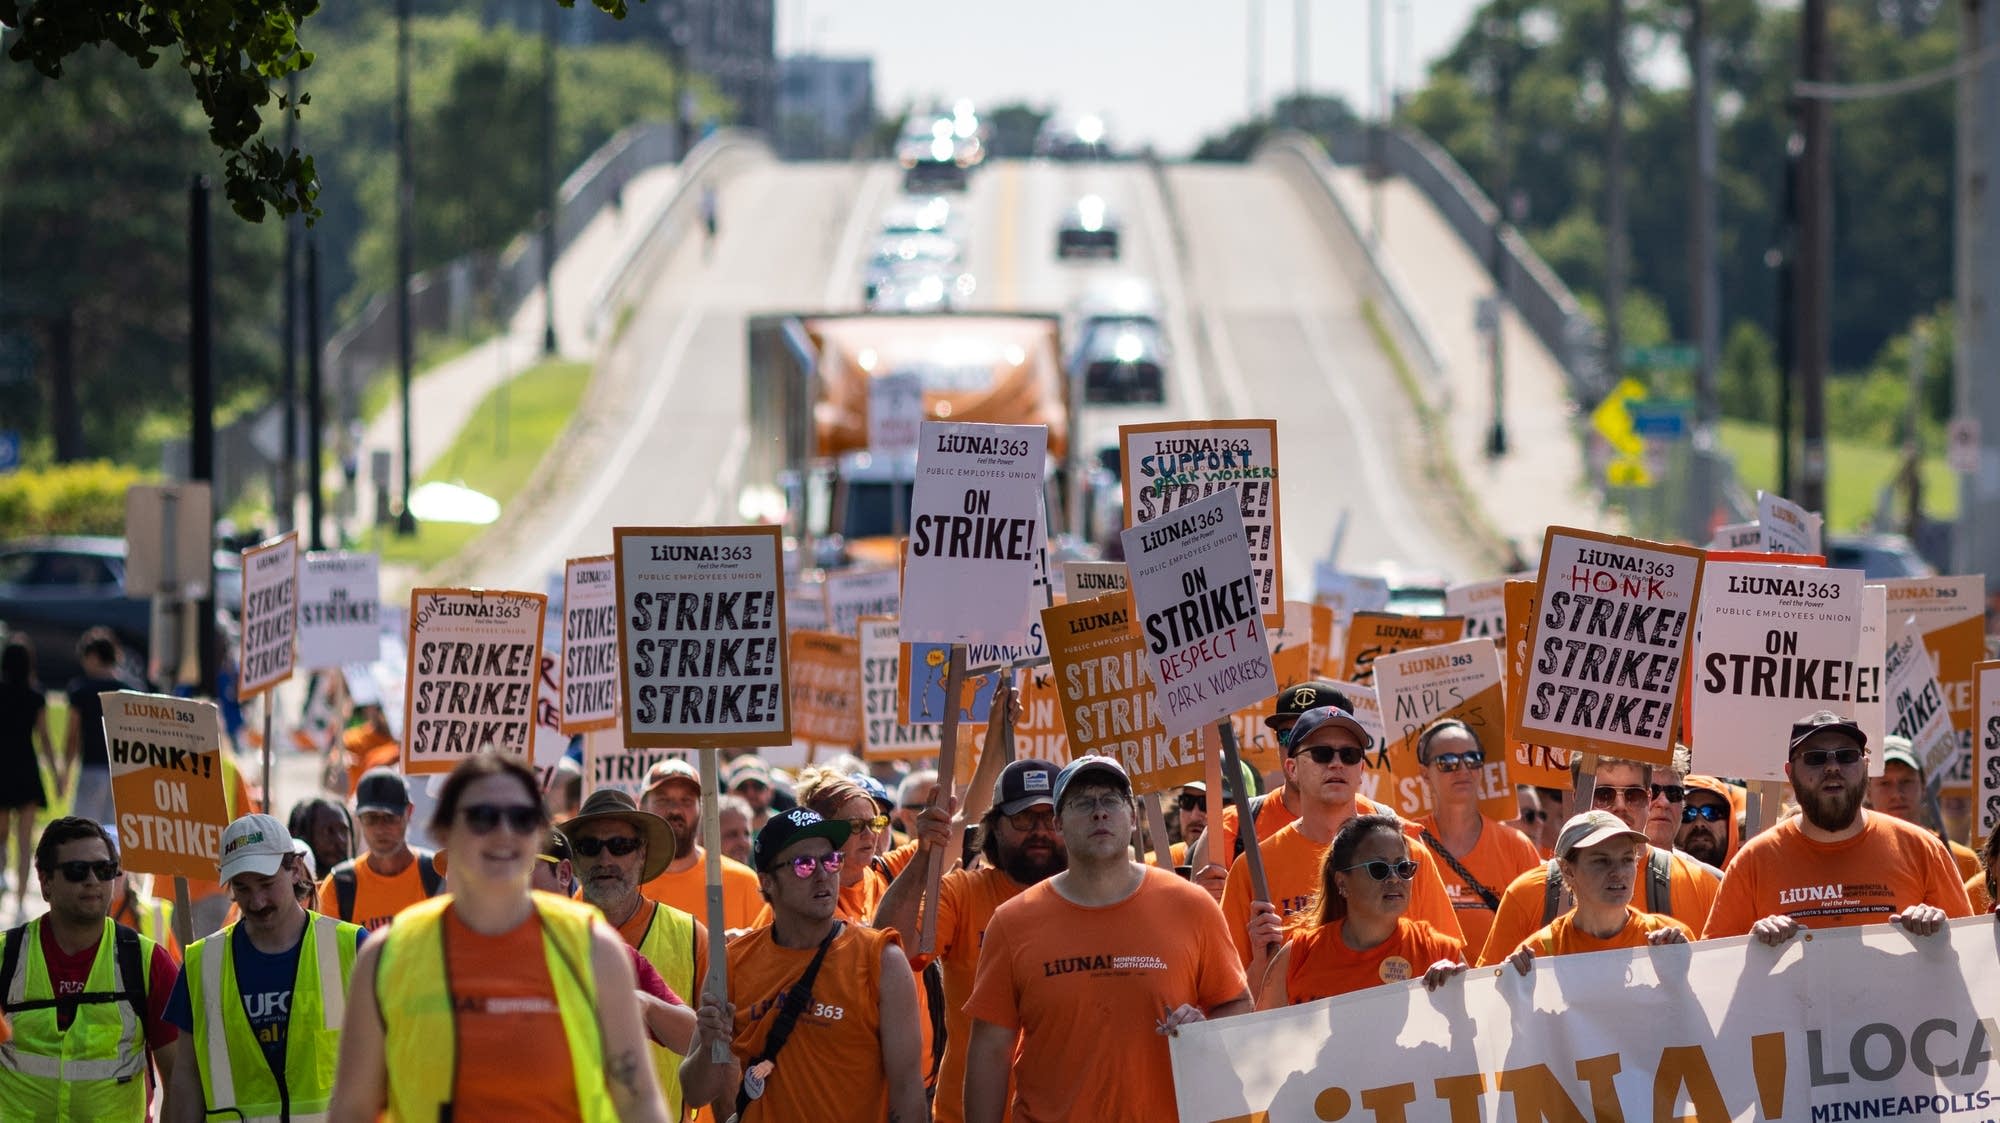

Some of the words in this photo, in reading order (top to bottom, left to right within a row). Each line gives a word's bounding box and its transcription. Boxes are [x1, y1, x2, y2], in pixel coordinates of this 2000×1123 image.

[937, 434, 998, 455] LiUNA!
[1000, 440, 1028, 456] 363
[1155, 438, 1218, 455] LiUNA!
[1221, 439, 1249, 452] 363
[926, 467, 954, 475] PUBLIC
[958, 469, 1005, 478] EMPLOYEES
[1140, 450, 1252, 477] SUPPORT
[1153, 472, 1199, 499] PARK
[1204, 468, 1279, 482] WORKERS
[964, 489, 990, 515] ON
[913, 514, 1036, 561] STRIKE!
[1141, 517, 1198, 553] LiUNA!
[1199, 507, 1224, 529] 363
[651, 545, 718, 561] LiUNA!
[721, 547, 752, 561] 363
[1139, 562, 1167, 577] PUBLIC
[1169, 544, 1211, 567] EMPLOYEES
[1214, 532, 1239, 547] UNION
[1577, 548, 1644, 573] LiUNA!
[1645, 561, 1674, 577] 363
[674, 573, 728, 581] EMPLOYEES
[731, 572, 763, 580] UNION
[1077, 573, 1118, 589] LiUNA!
[1182, 567, 1208, 597] ON
[1572, 564, 1665, 601] HONK
[1728, 575, 1805, 598] LiUNA!
[1807, 583, 1840, 599] 363
[411, 591, 447, 634] HONK
[440, 602, 494, 617] LiUNA!
[496, 606, 520, 618] 363
[567, 605, 616, 642] STRIKE!
[632, 590, 775, 631] STRIKE!
[1069, 609, 1128, 634] LiUNA!
[1146, 575, 1257, 655] STRIKE!
[1545, 590, 1687, 649] STRIKE!
[1716, 606, 1752, 617] PUBLIC
[1756, 609, 1814, 620] EMPLOYEES
[1819, 613, 1851, 622] UNION
[1247, 620, 1258, 643] 4
[1765, 630, 1798, 655] ON
[418, 641, 534, 677] STRIKE!
[567, 642, 616, 678] STRIKE!
[635, 637, 777, 678] STRIKE!
[1160, 629, 1237, 685] RESPECT
[1452, 654, 1473, 667] 363
[1537, 636, 1679, 694] STRIKE!
[1208, 657, 1268, 695] WORKERS
[1704, 652, 1853, 702] STRIKE!
[124, 703, 175, 721] LiUNA!
[176, 711, 195, 723] 363
[416, 681, 531, 715] STRIKE!
[565, 679, 616, 716] STRIKE!
[636, 683, 779, 724] STRIKE!
[1168, 681, 1207, 716] PARK
[1395, 687, 1464, 721] MPLS
[1530, 681, 1672, 740] STRIKE!
[414, 719, 528, 754] STRIKE!
[112, 738, 212, 779] HONK!!
[154, 779, 188, 814] ON
[1779, 884, 1843, 905] LiUNA!
[1044, 954, 1112, 977] LiUNA!
[1139, 962, 1168, 970] DAKOTA
[814, 1003, 844, 1020] 363
